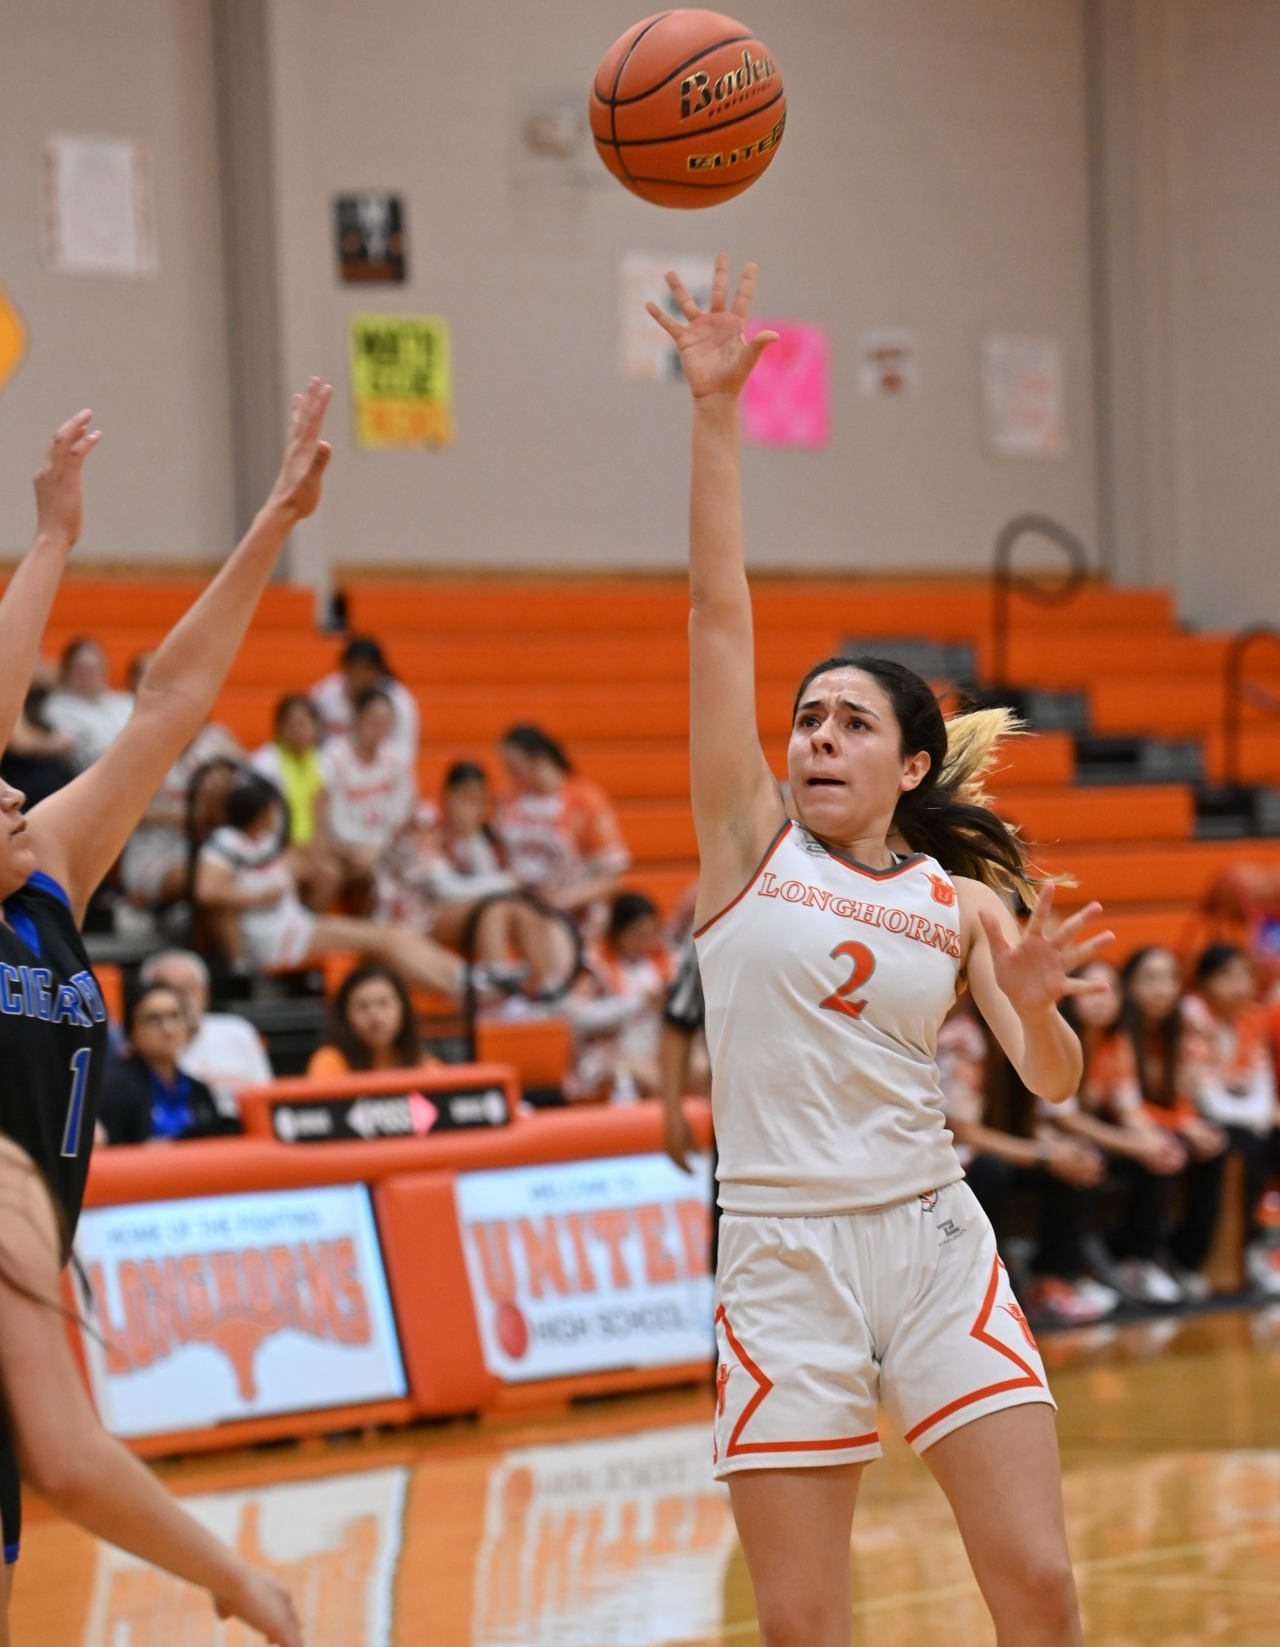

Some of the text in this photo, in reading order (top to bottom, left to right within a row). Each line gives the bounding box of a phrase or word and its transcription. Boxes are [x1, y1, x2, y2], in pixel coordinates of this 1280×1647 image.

[680, 48, 776, 123] Baden
[758, 872, 961, 958] LONGHORNS
[818, 940, 876, 1020] 2
[60, 1047, 92, 1158] 1
[470, 1201, 712, 1302] UNITED
[89, 1236, 372, 1377] LONGHORNS
